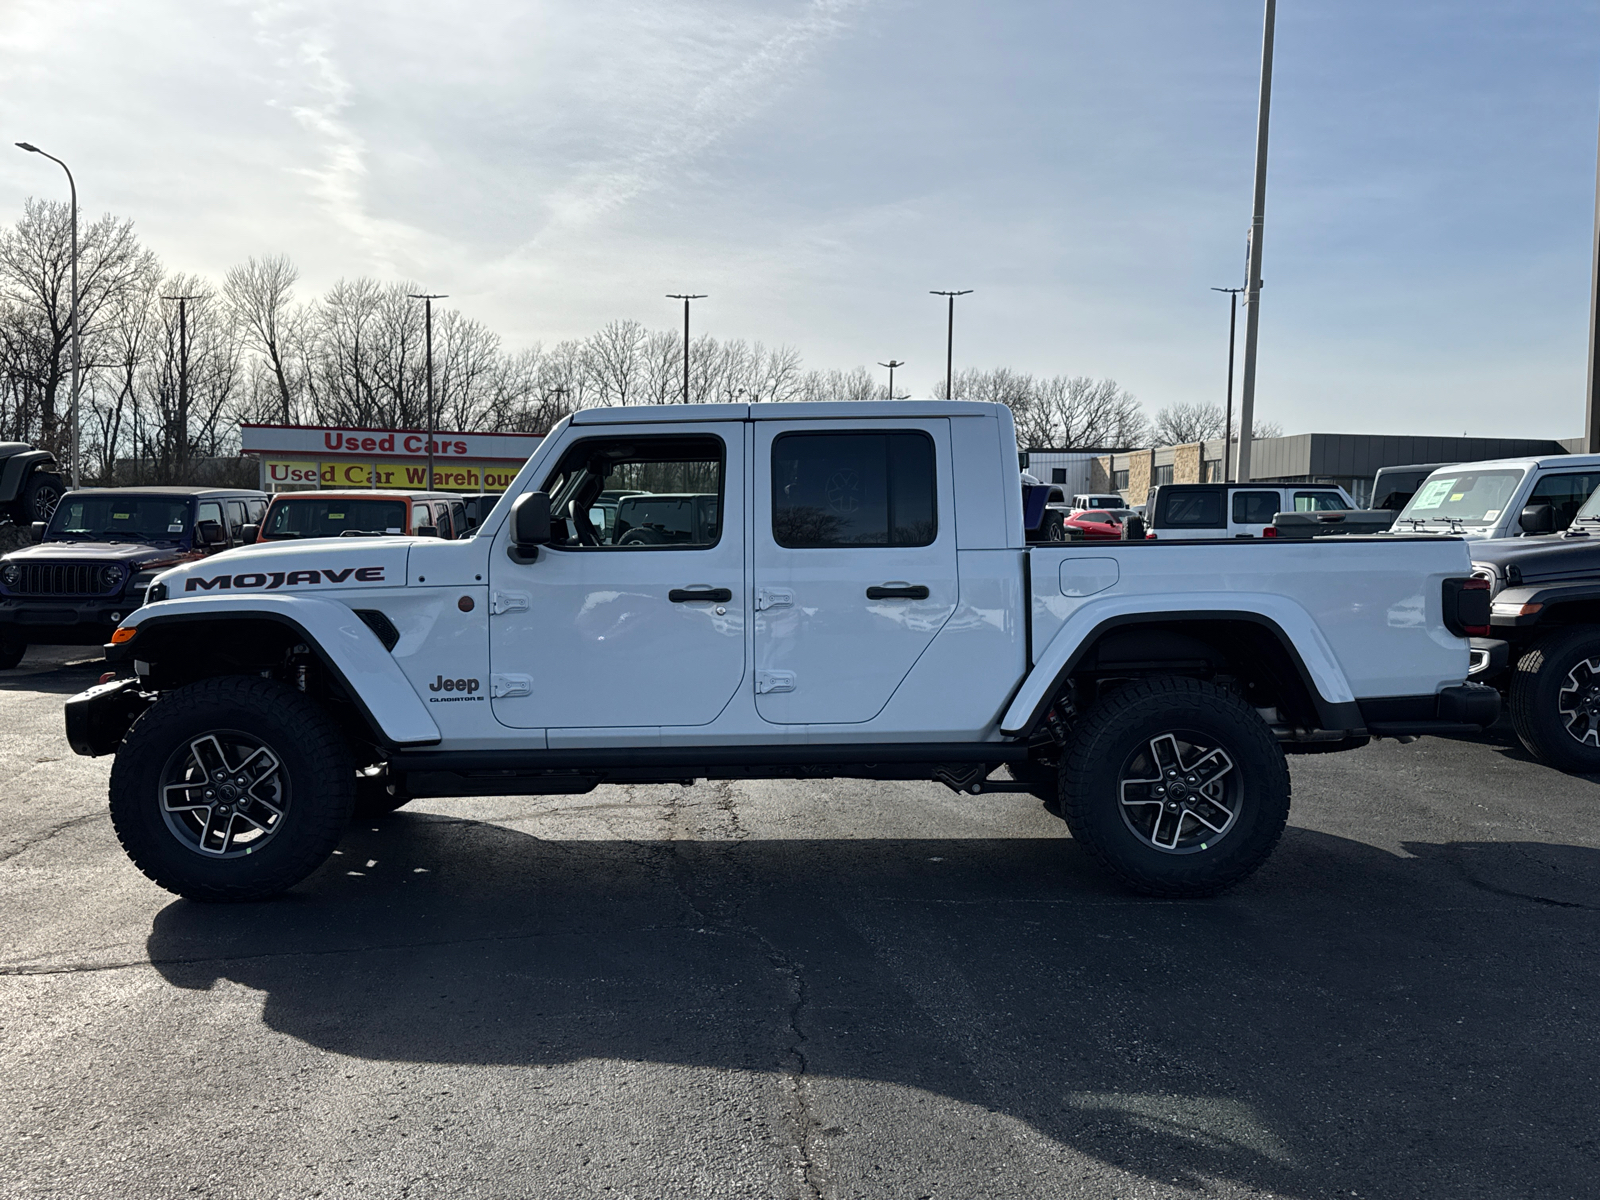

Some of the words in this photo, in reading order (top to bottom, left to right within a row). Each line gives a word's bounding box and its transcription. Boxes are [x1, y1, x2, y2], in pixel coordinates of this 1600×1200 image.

[324, 432, 395, 452] Used
[403, 435, 468, 455] Cars
[268, 464, 337, 483] Used
[344, 465, 395, 484] Car
[184, 566, 386, 592] MOJAVE
[429, 675, 480, 695] Jeep
